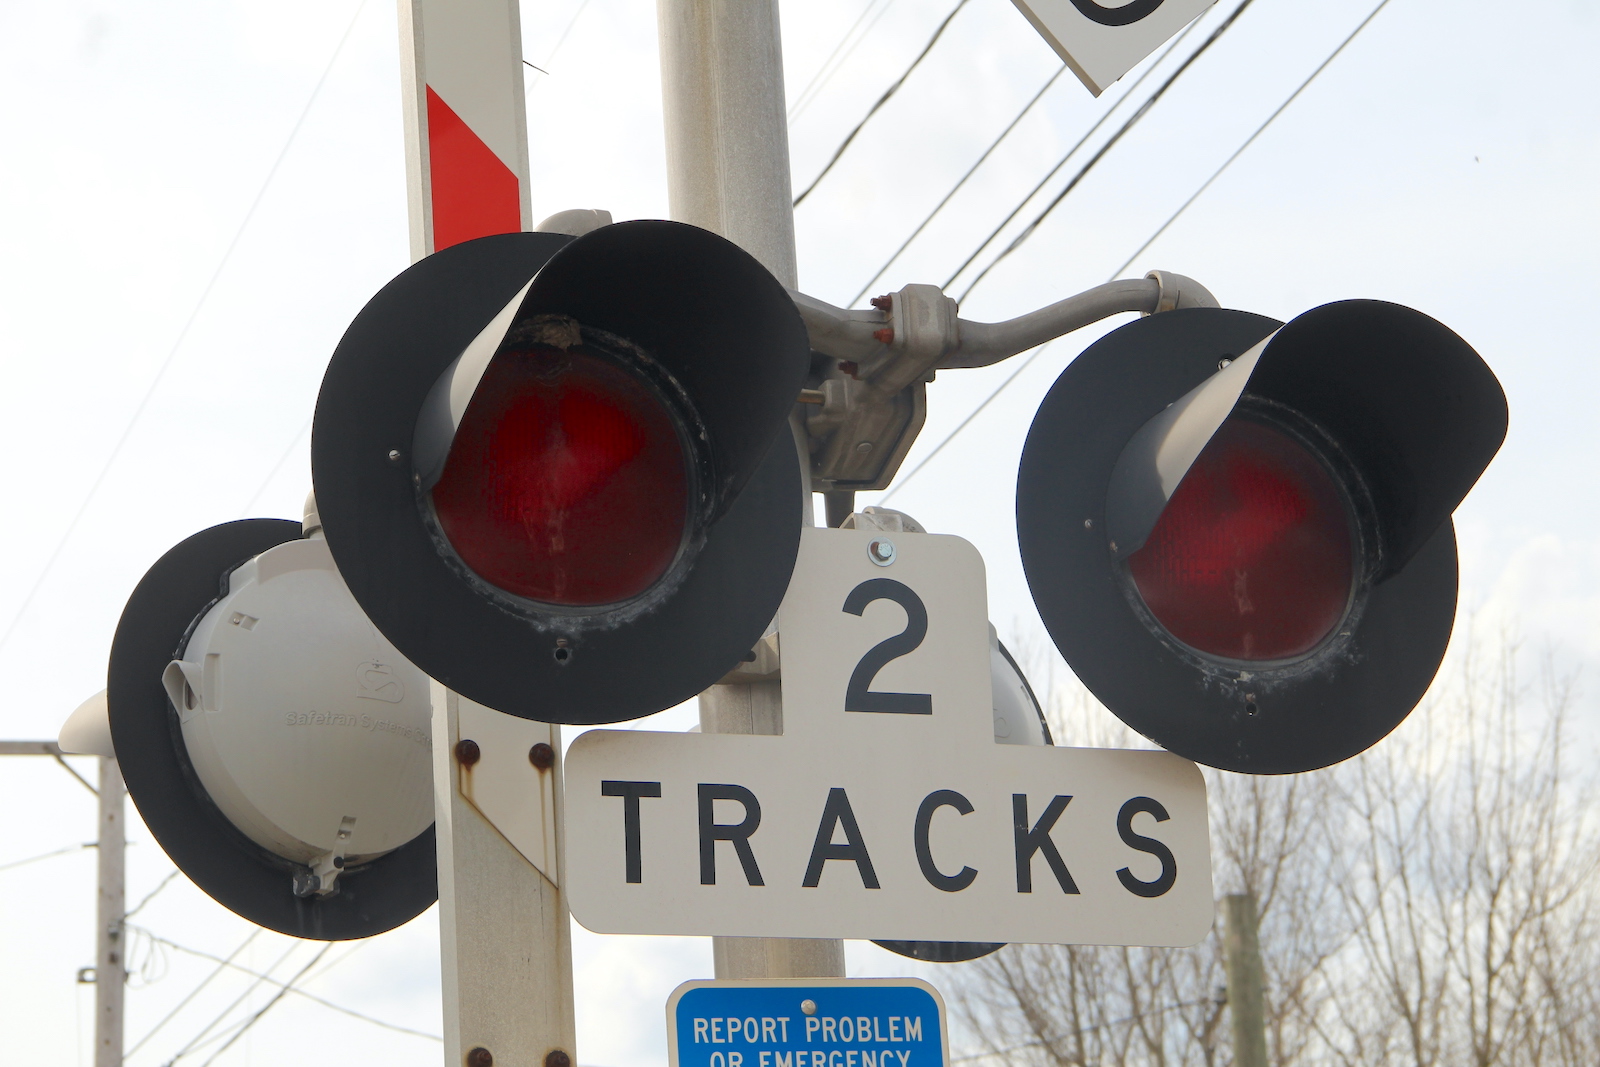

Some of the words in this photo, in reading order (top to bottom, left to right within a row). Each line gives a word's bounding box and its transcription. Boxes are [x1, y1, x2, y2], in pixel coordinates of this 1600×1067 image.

[842, 578, 932, 715] 2
[285, 710, 357, 727] Safetran
[361, 713, 412, 739] Systems
[601, 780, 1178, 898] TRACKS
[693, 1017, 790, 1044] REPORT
[805, 1016, 922, 1043] PROBLEM
[709, 1051, 743, 1067] OR
[759, 1050, 911, 1067] EMERGENCY
